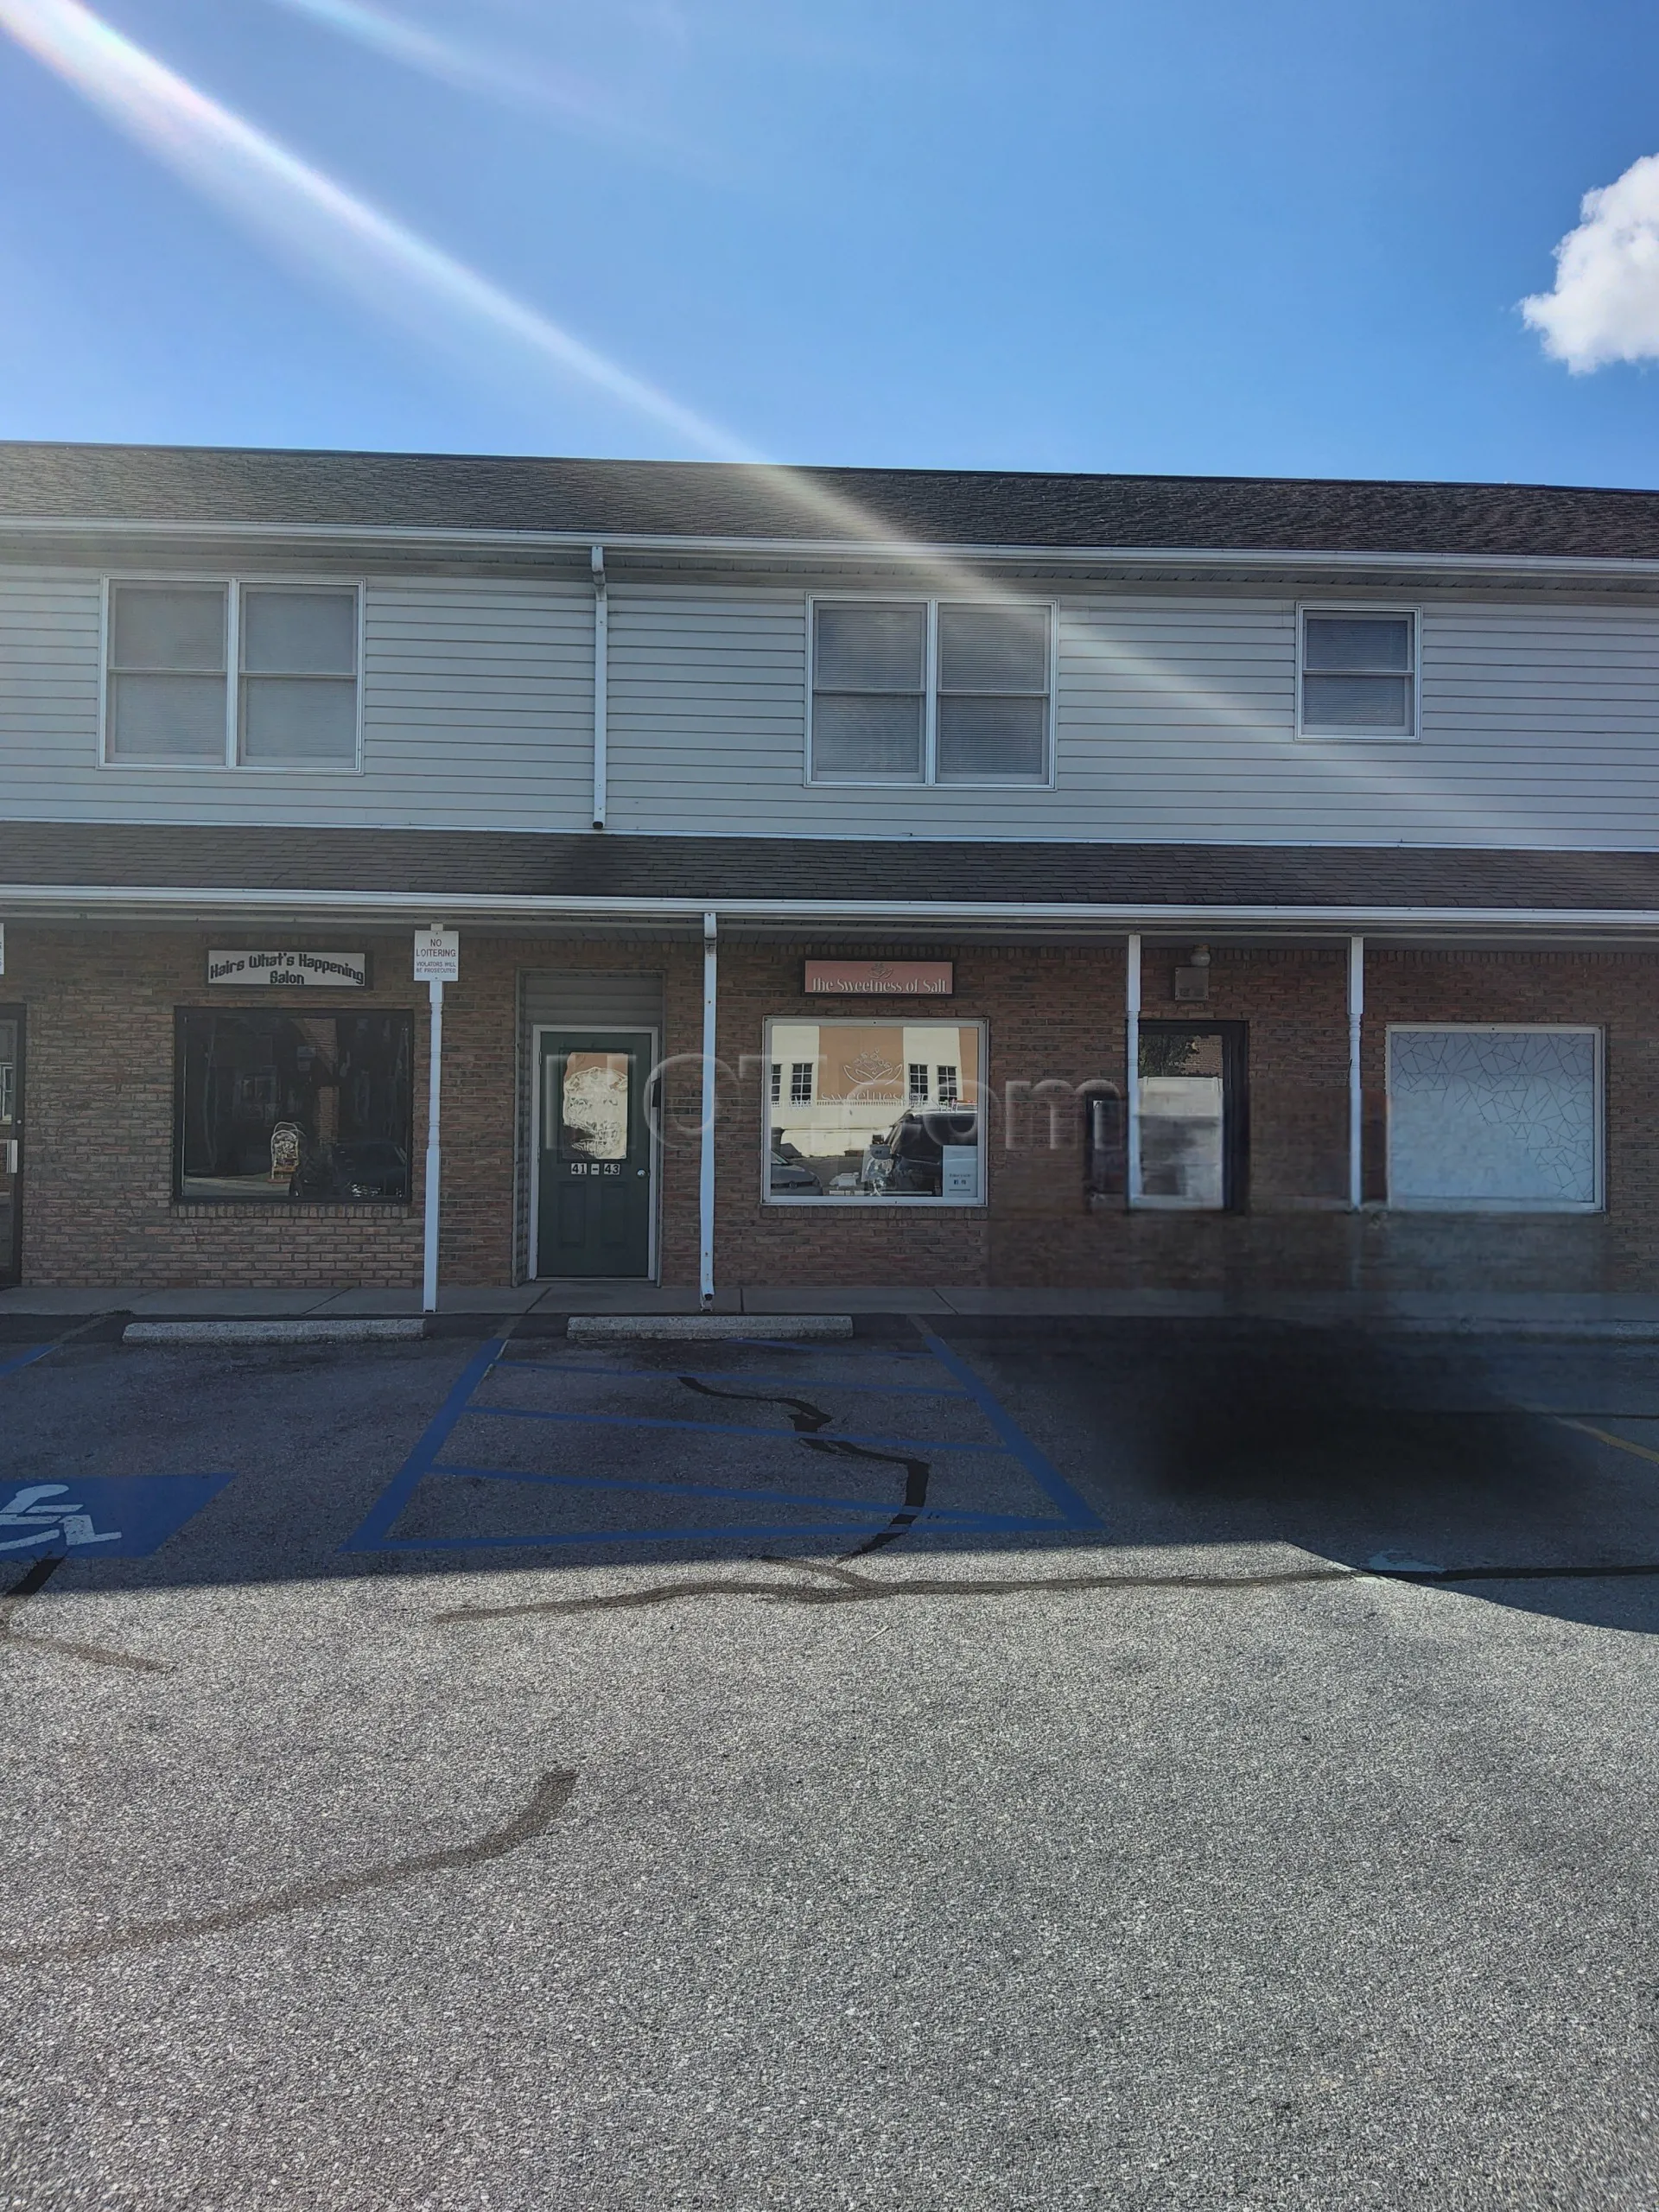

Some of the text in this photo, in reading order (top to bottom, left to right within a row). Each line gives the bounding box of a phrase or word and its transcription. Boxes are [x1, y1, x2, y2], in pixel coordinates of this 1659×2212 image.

[430, 938, 442, 947] NO
[416, 949, 456, 957] LOITERING
[210, 952, 364, 985] Hairs What's Happening
[270, 970, 305, 984] Salon
[812, 977, 947, 993] The Sweetness of Salt
[572, 1164, 586, 1174] 41
[605, 1164, 619, 1174] 43
